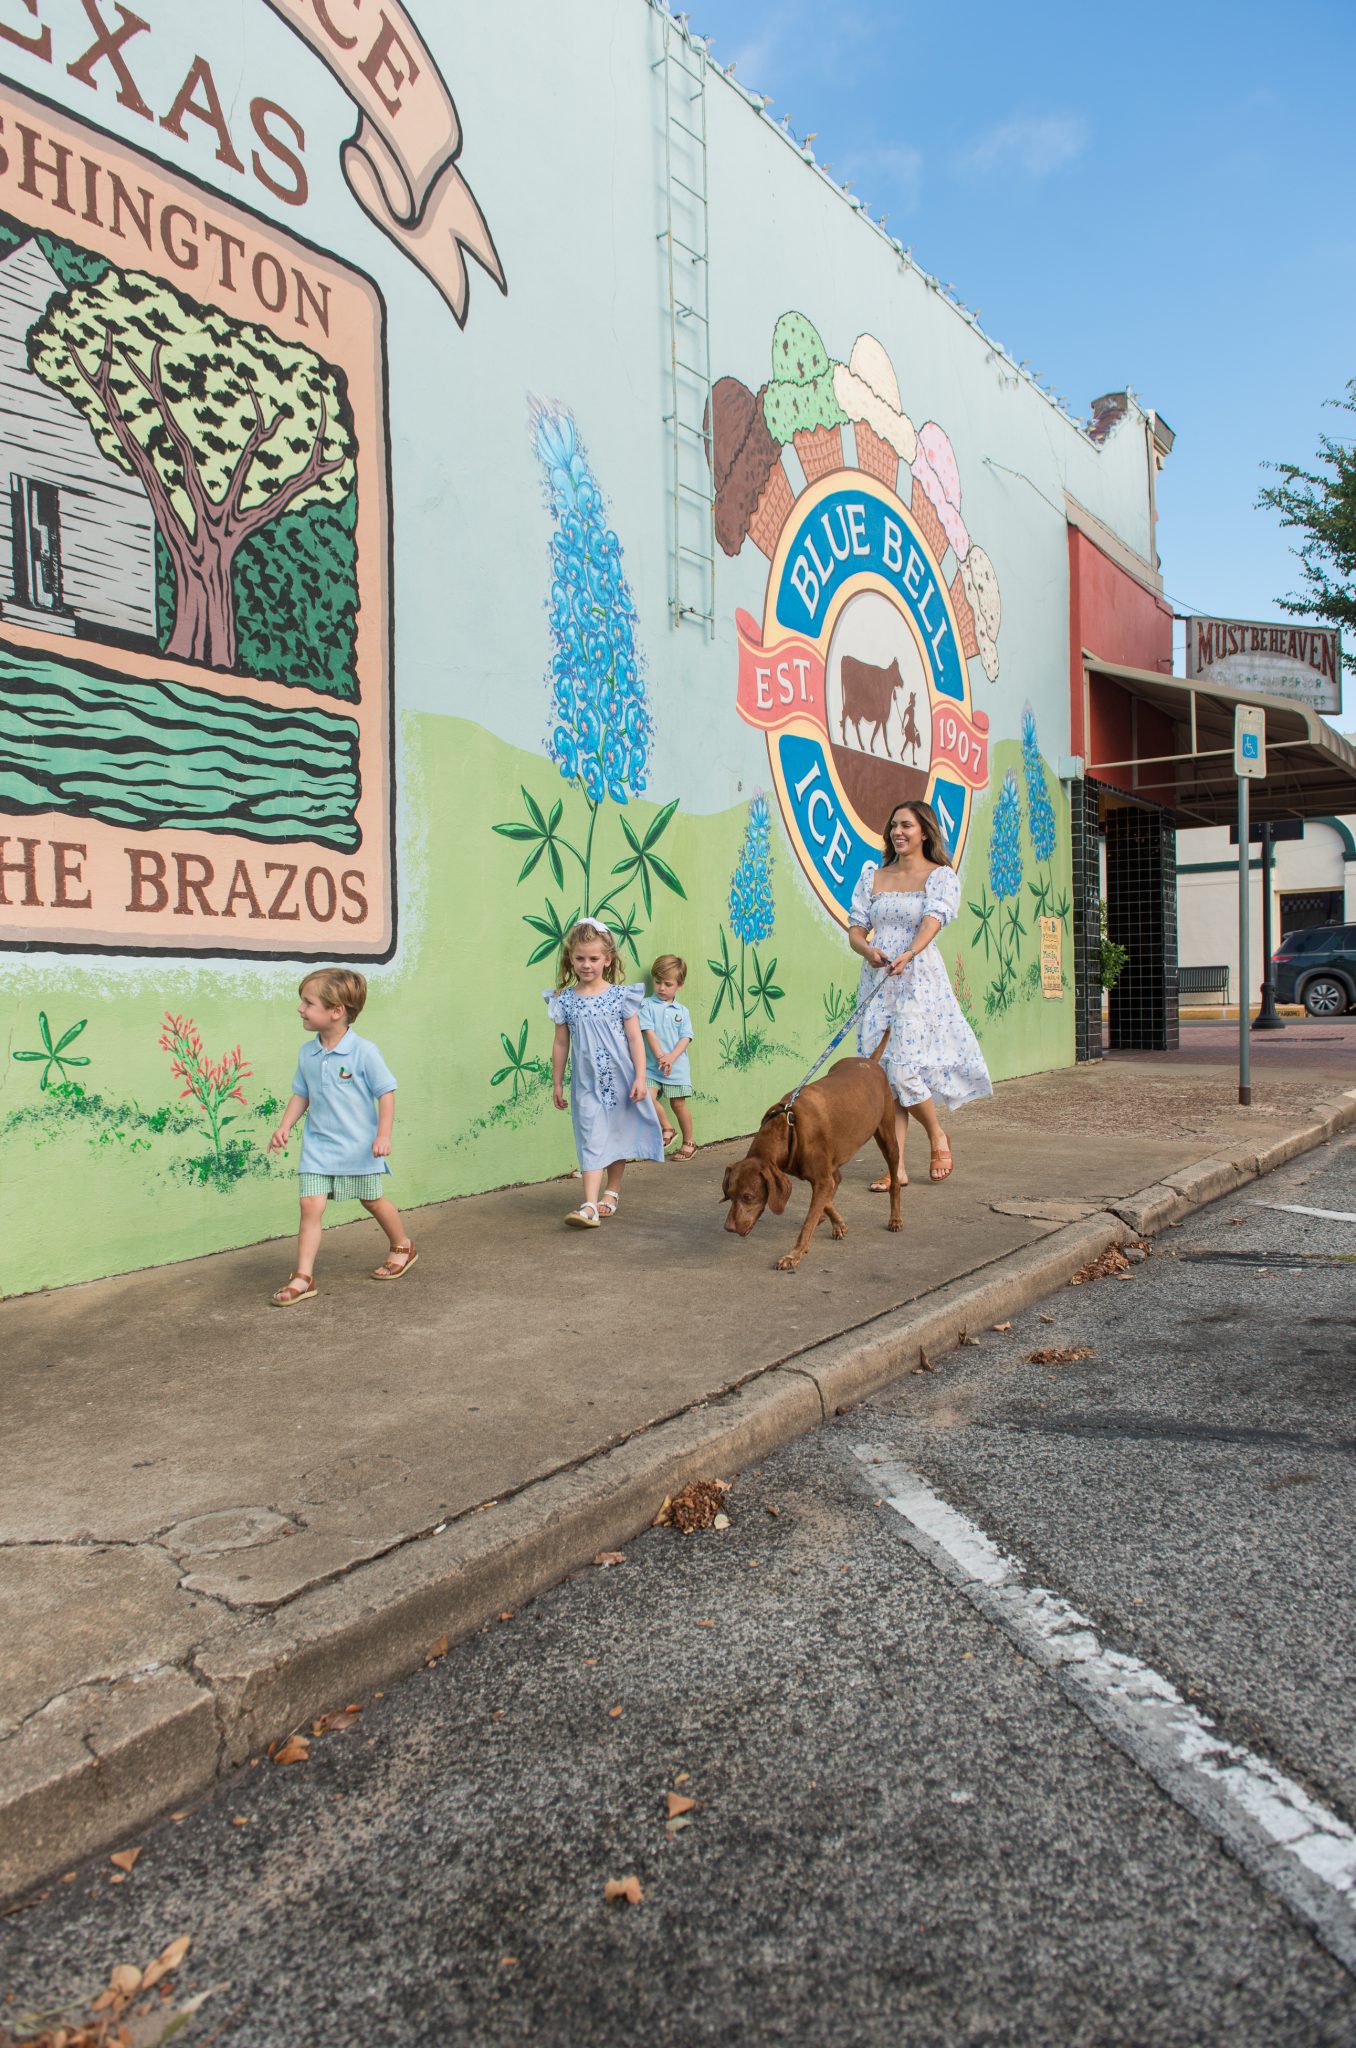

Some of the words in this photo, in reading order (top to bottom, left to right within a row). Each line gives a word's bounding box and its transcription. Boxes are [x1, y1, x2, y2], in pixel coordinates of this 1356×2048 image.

[791, 504, 871, 619] BLUE
[882, 516, 949, 672] BELL
[755, 658, 815, 710] EST.
[1197, 621, 1249, 673] MUST
[1250, 626, 1269, 651] BE
[1268, 628, 1337, 684] HEAVEN
[938, 717, 982, 774] 1907
[794, 760, 852, 884] ICE
[0, 836, 92, 909] HE
[124, 848, 369, 925] BRAZOS
